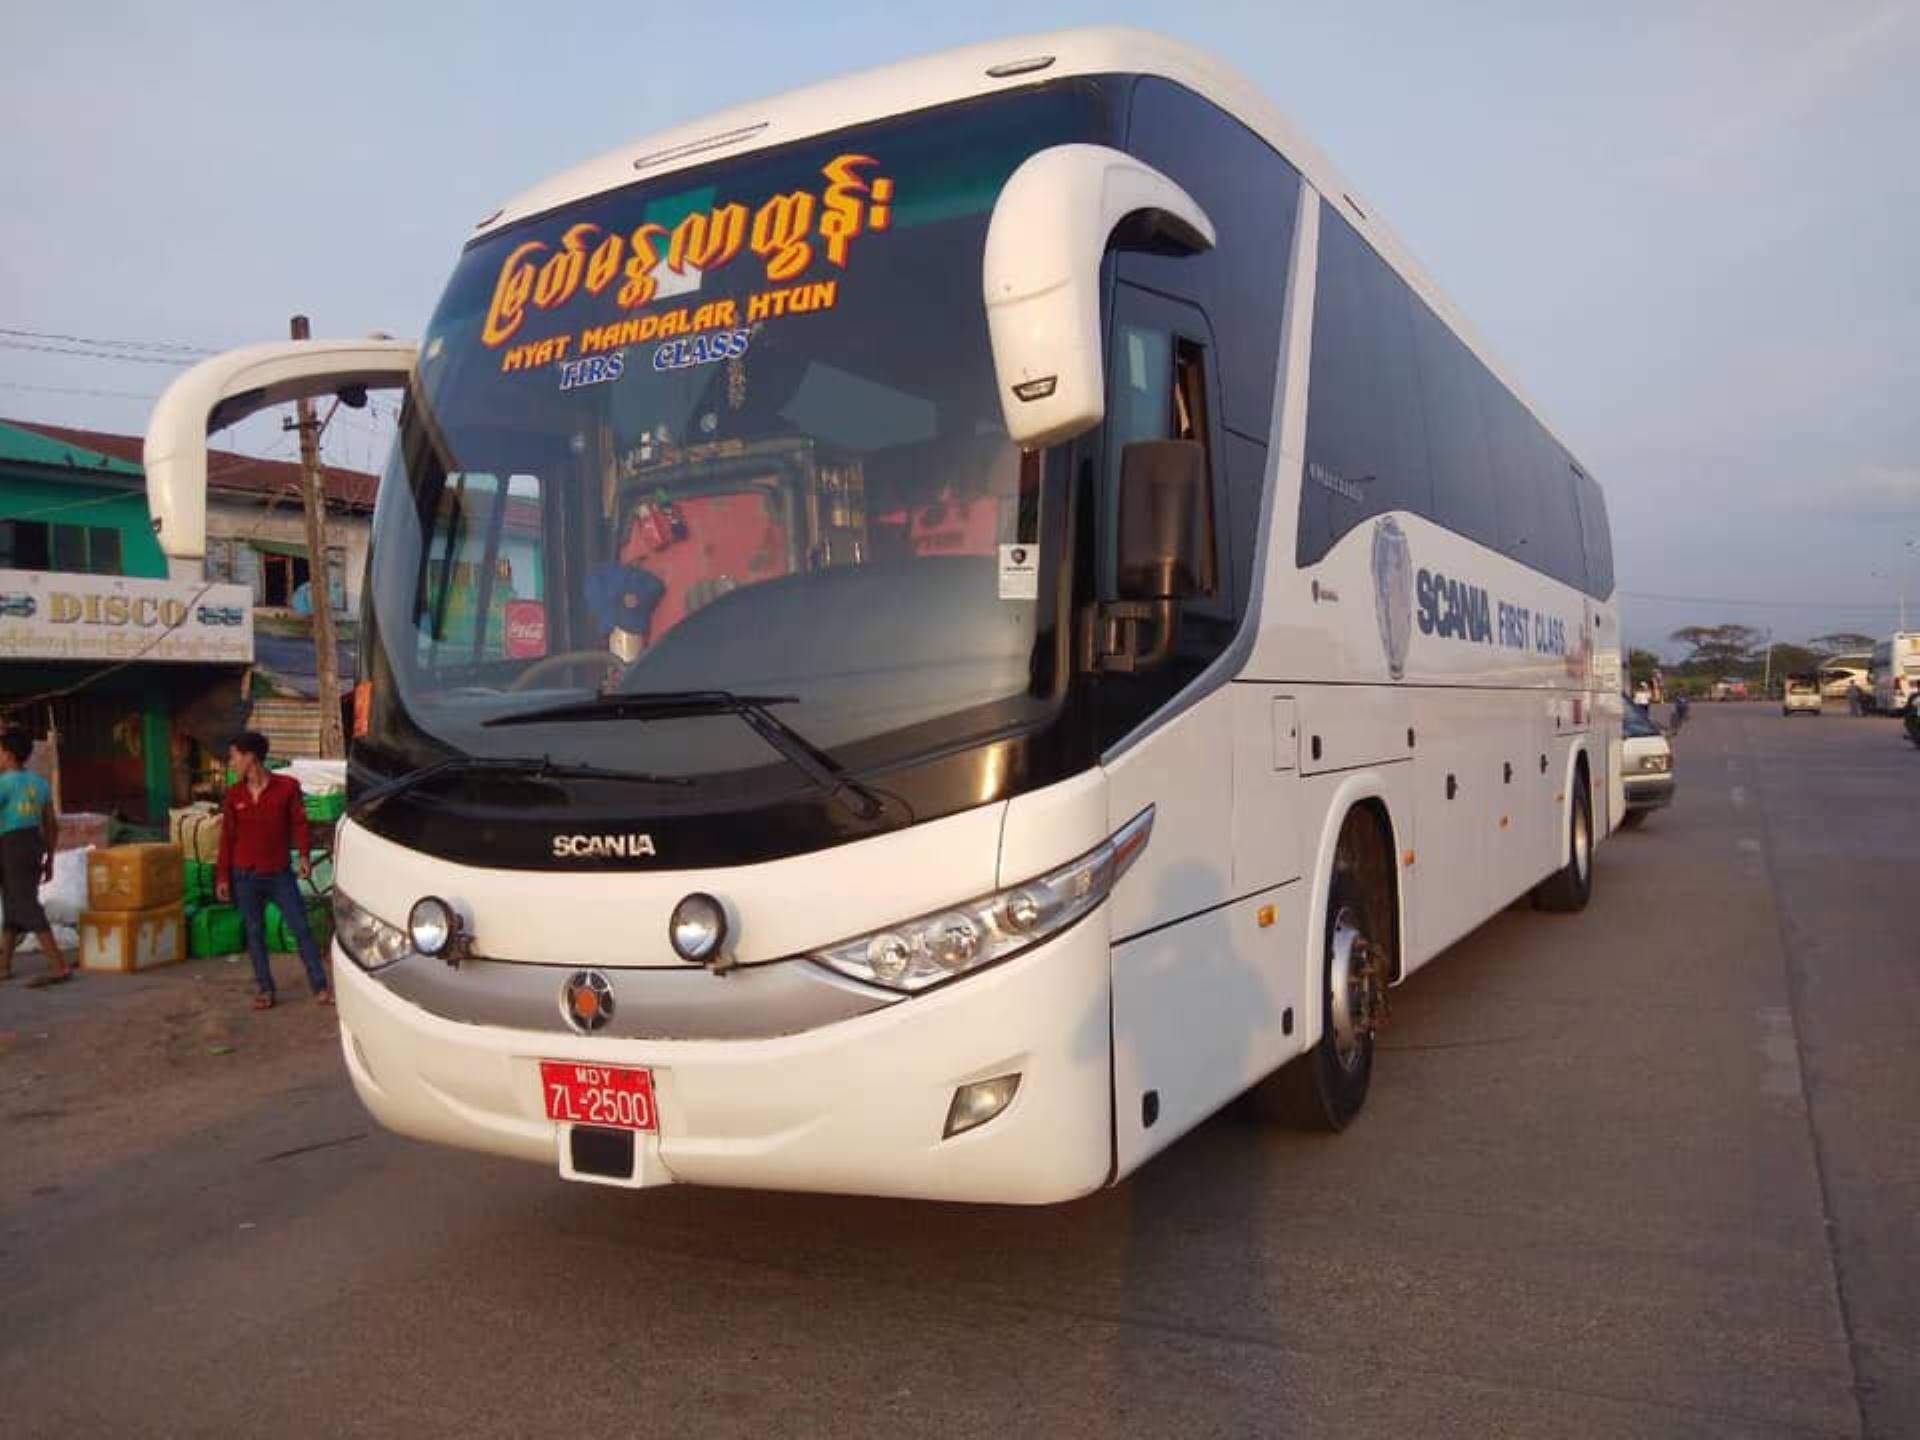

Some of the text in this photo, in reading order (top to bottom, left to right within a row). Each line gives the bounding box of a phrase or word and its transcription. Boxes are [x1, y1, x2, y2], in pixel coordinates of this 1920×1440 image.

[502, 280, 838, 372] MYAT MANDALAR HTUN
[653, 328, 751, 371] CLASS
[48, 591, 189, 628] DISCO
[1416, 568, 1492, 645] SCANIA
[1498, 600, 1530, 650] FIRST
[552, 834, 657, 857] SCANIA
[575, 1067, 612, 1086] MDY
[549, 1083, 650, 1127] 7L-2500
